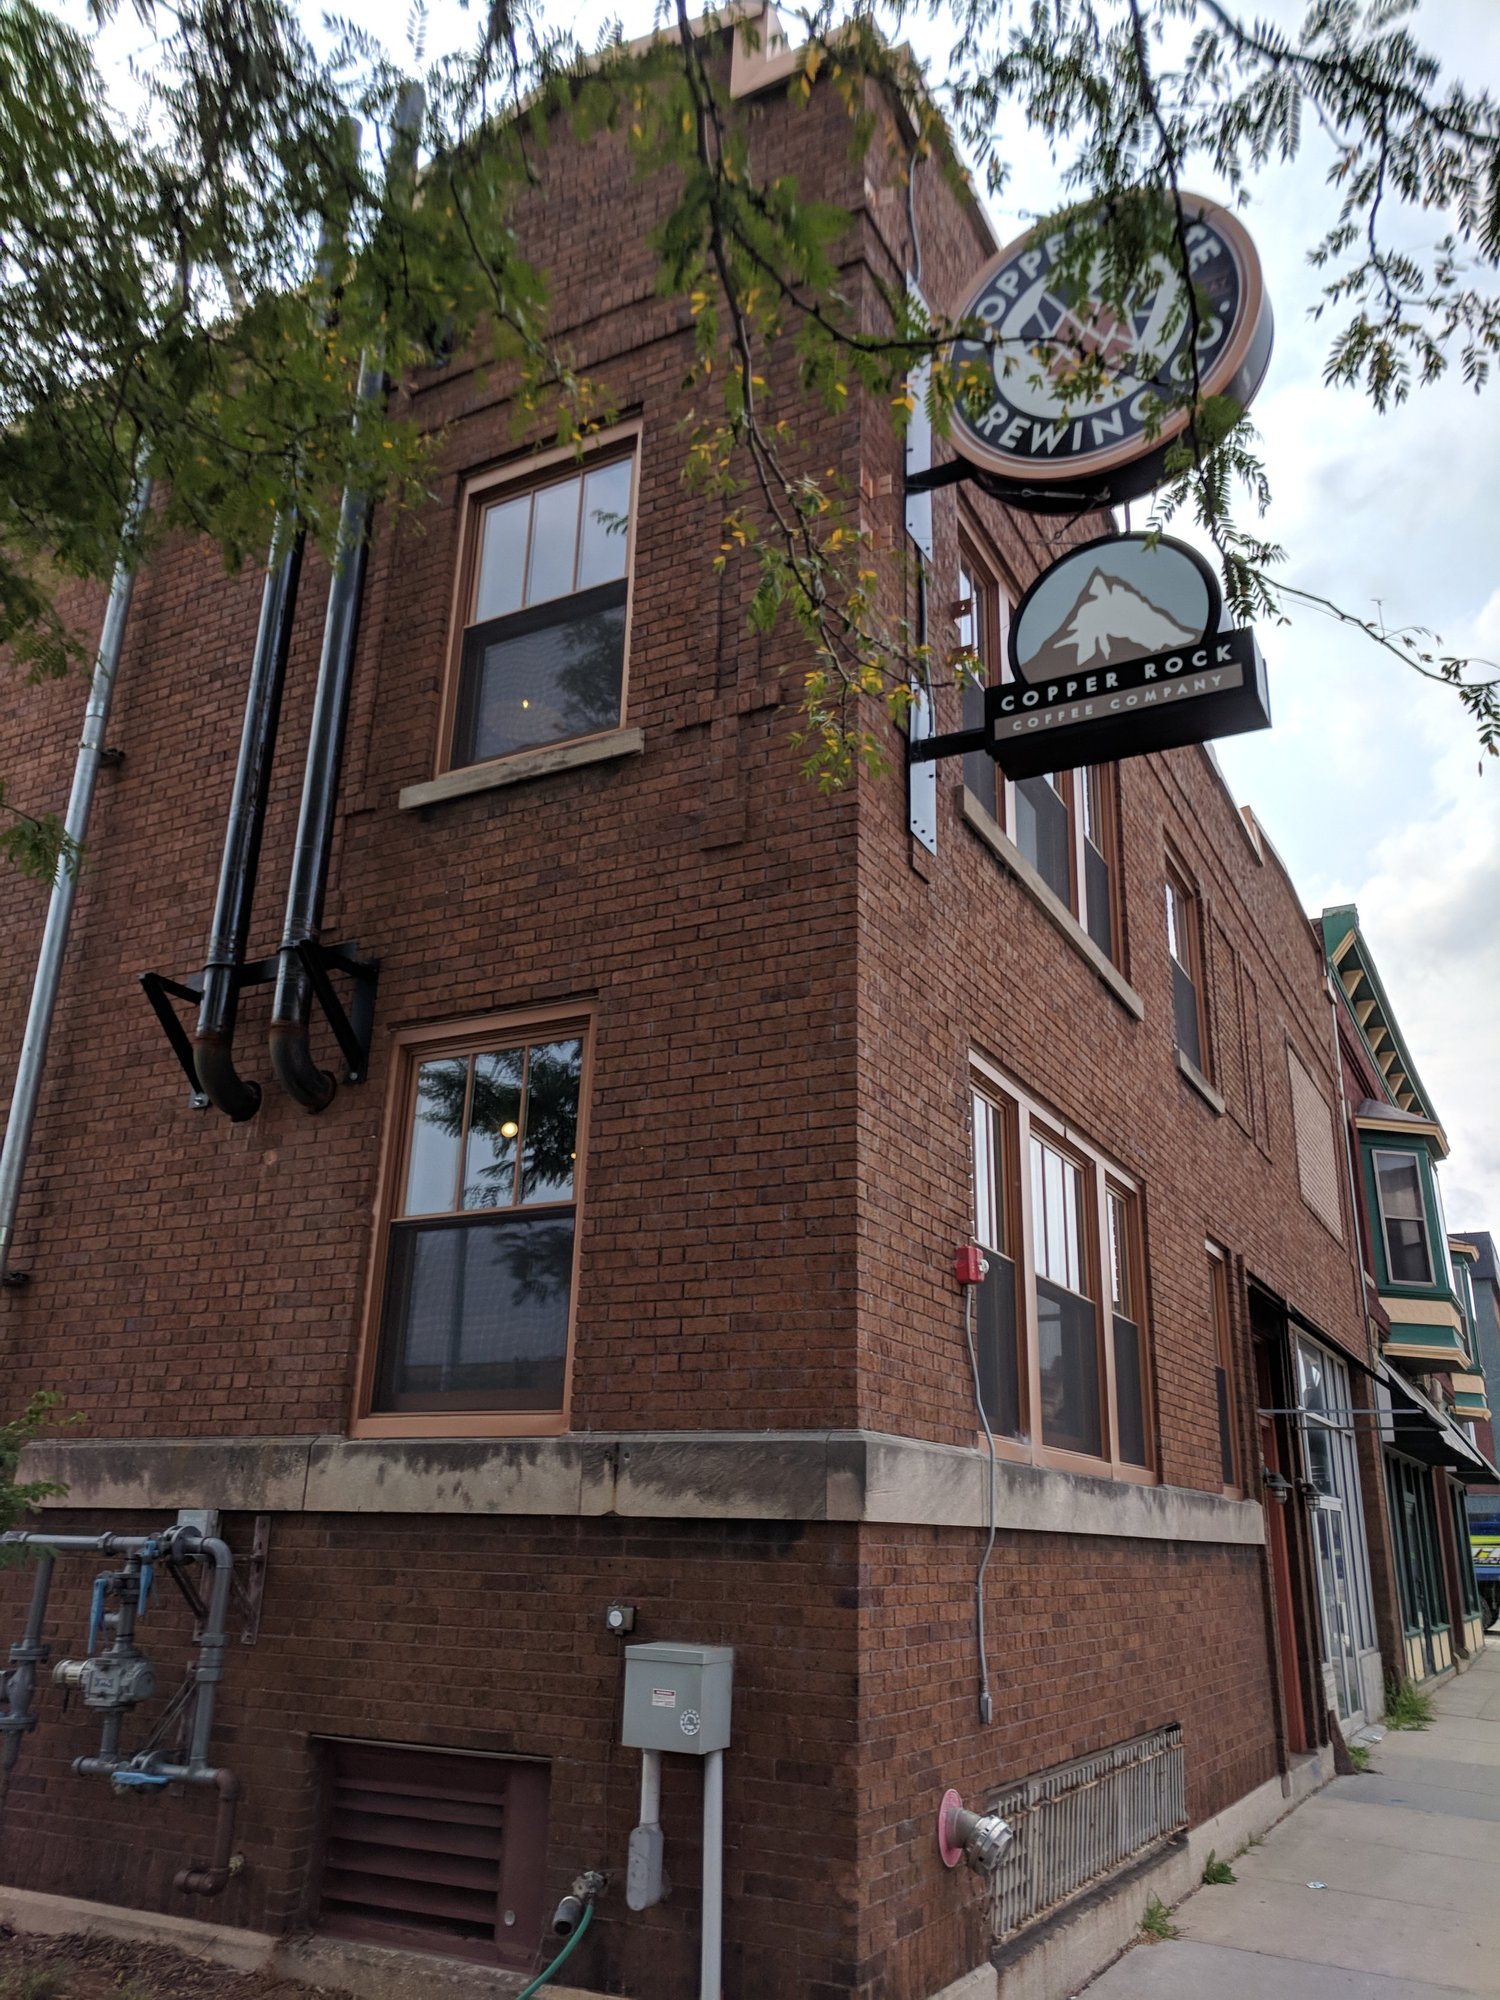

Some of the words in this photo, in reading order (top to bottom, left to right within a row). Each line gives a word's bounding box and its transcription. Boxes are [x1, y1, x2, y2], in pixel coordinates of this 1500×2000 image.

[962, 218, 1099, 351] OPPE
[1000, 671, 1119, 712] COPPER
[1143, 643, 1233, 680] ROCK
[1011, 703, 1095, 732] COFFEE
[1109, 674, 1222, 710] COMPANY
